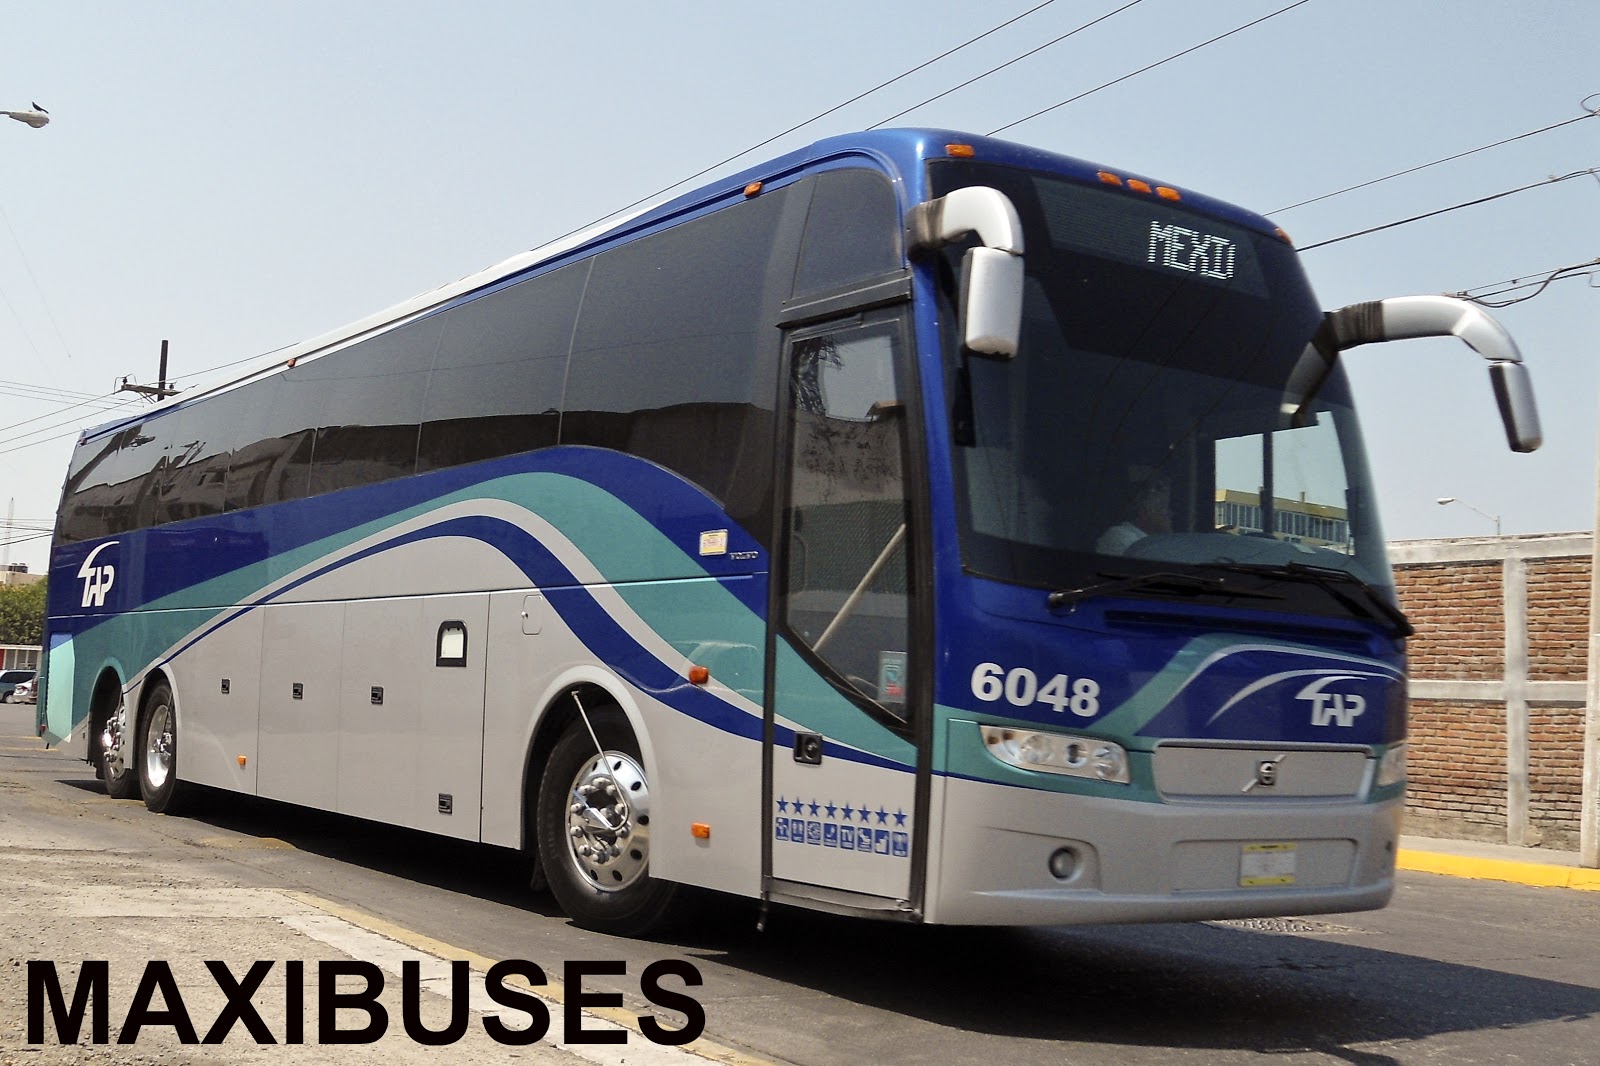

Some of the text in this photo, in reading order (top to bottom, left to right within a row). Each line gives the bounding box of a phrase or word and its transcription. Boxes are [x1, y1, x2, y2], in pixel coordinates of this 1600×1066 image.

[77, 541, 119, 607] TAP
[971, 662, 1100, 717] 6048
[1295, 675, 1367, 726] TAP
